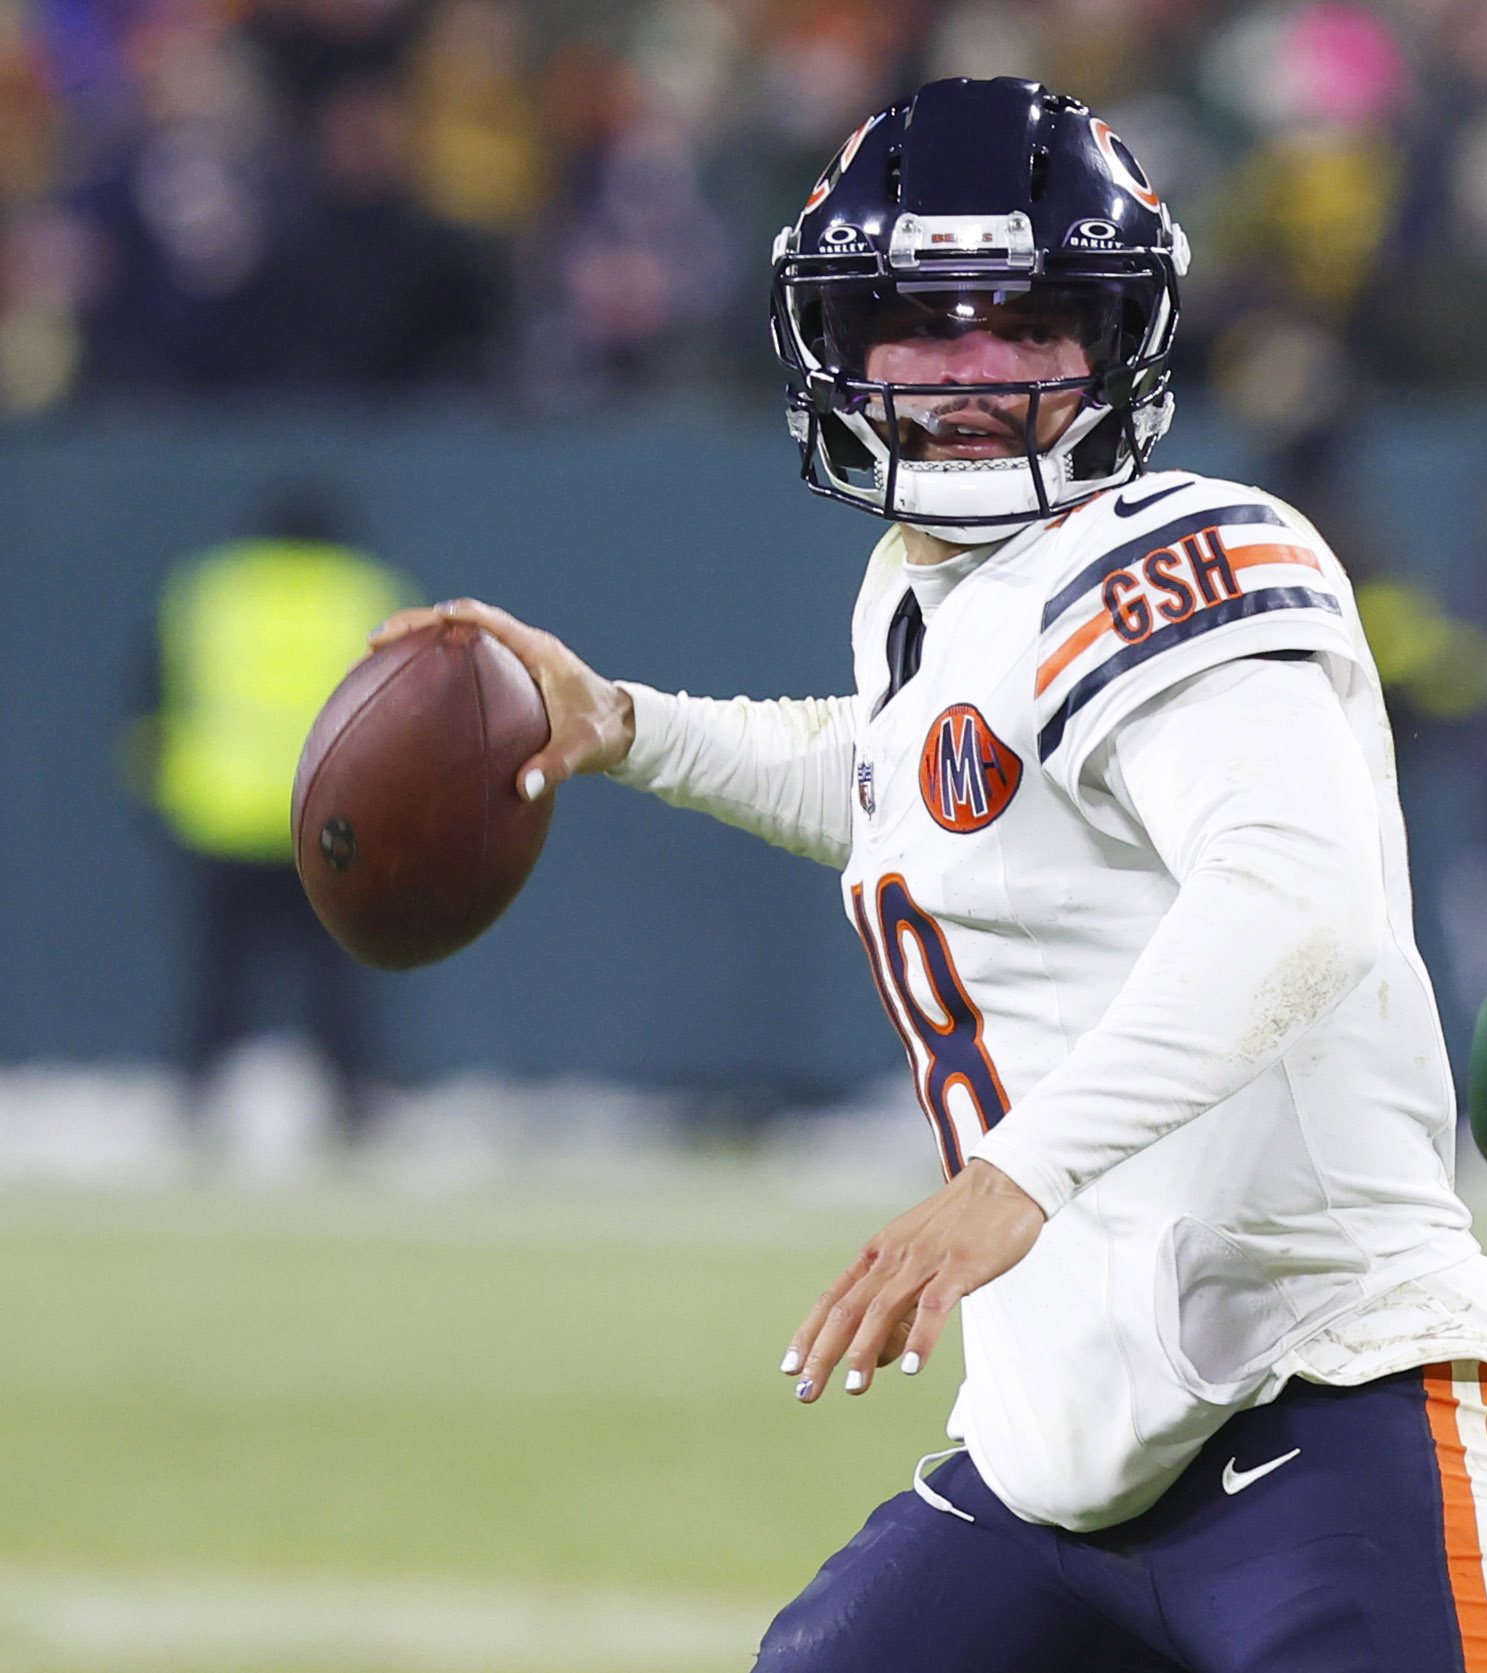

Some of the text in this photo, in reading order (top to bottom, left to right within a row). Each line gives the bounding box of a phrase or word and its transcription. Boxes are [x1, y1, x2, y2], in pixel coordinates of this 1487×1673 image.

[931, 233, 994, 244] BES
[1069, 236, 1124, 249] OAKLEY
[818, 243, 868, 254] OAKLEY
[1101, 525, 1244, 645] GSH
